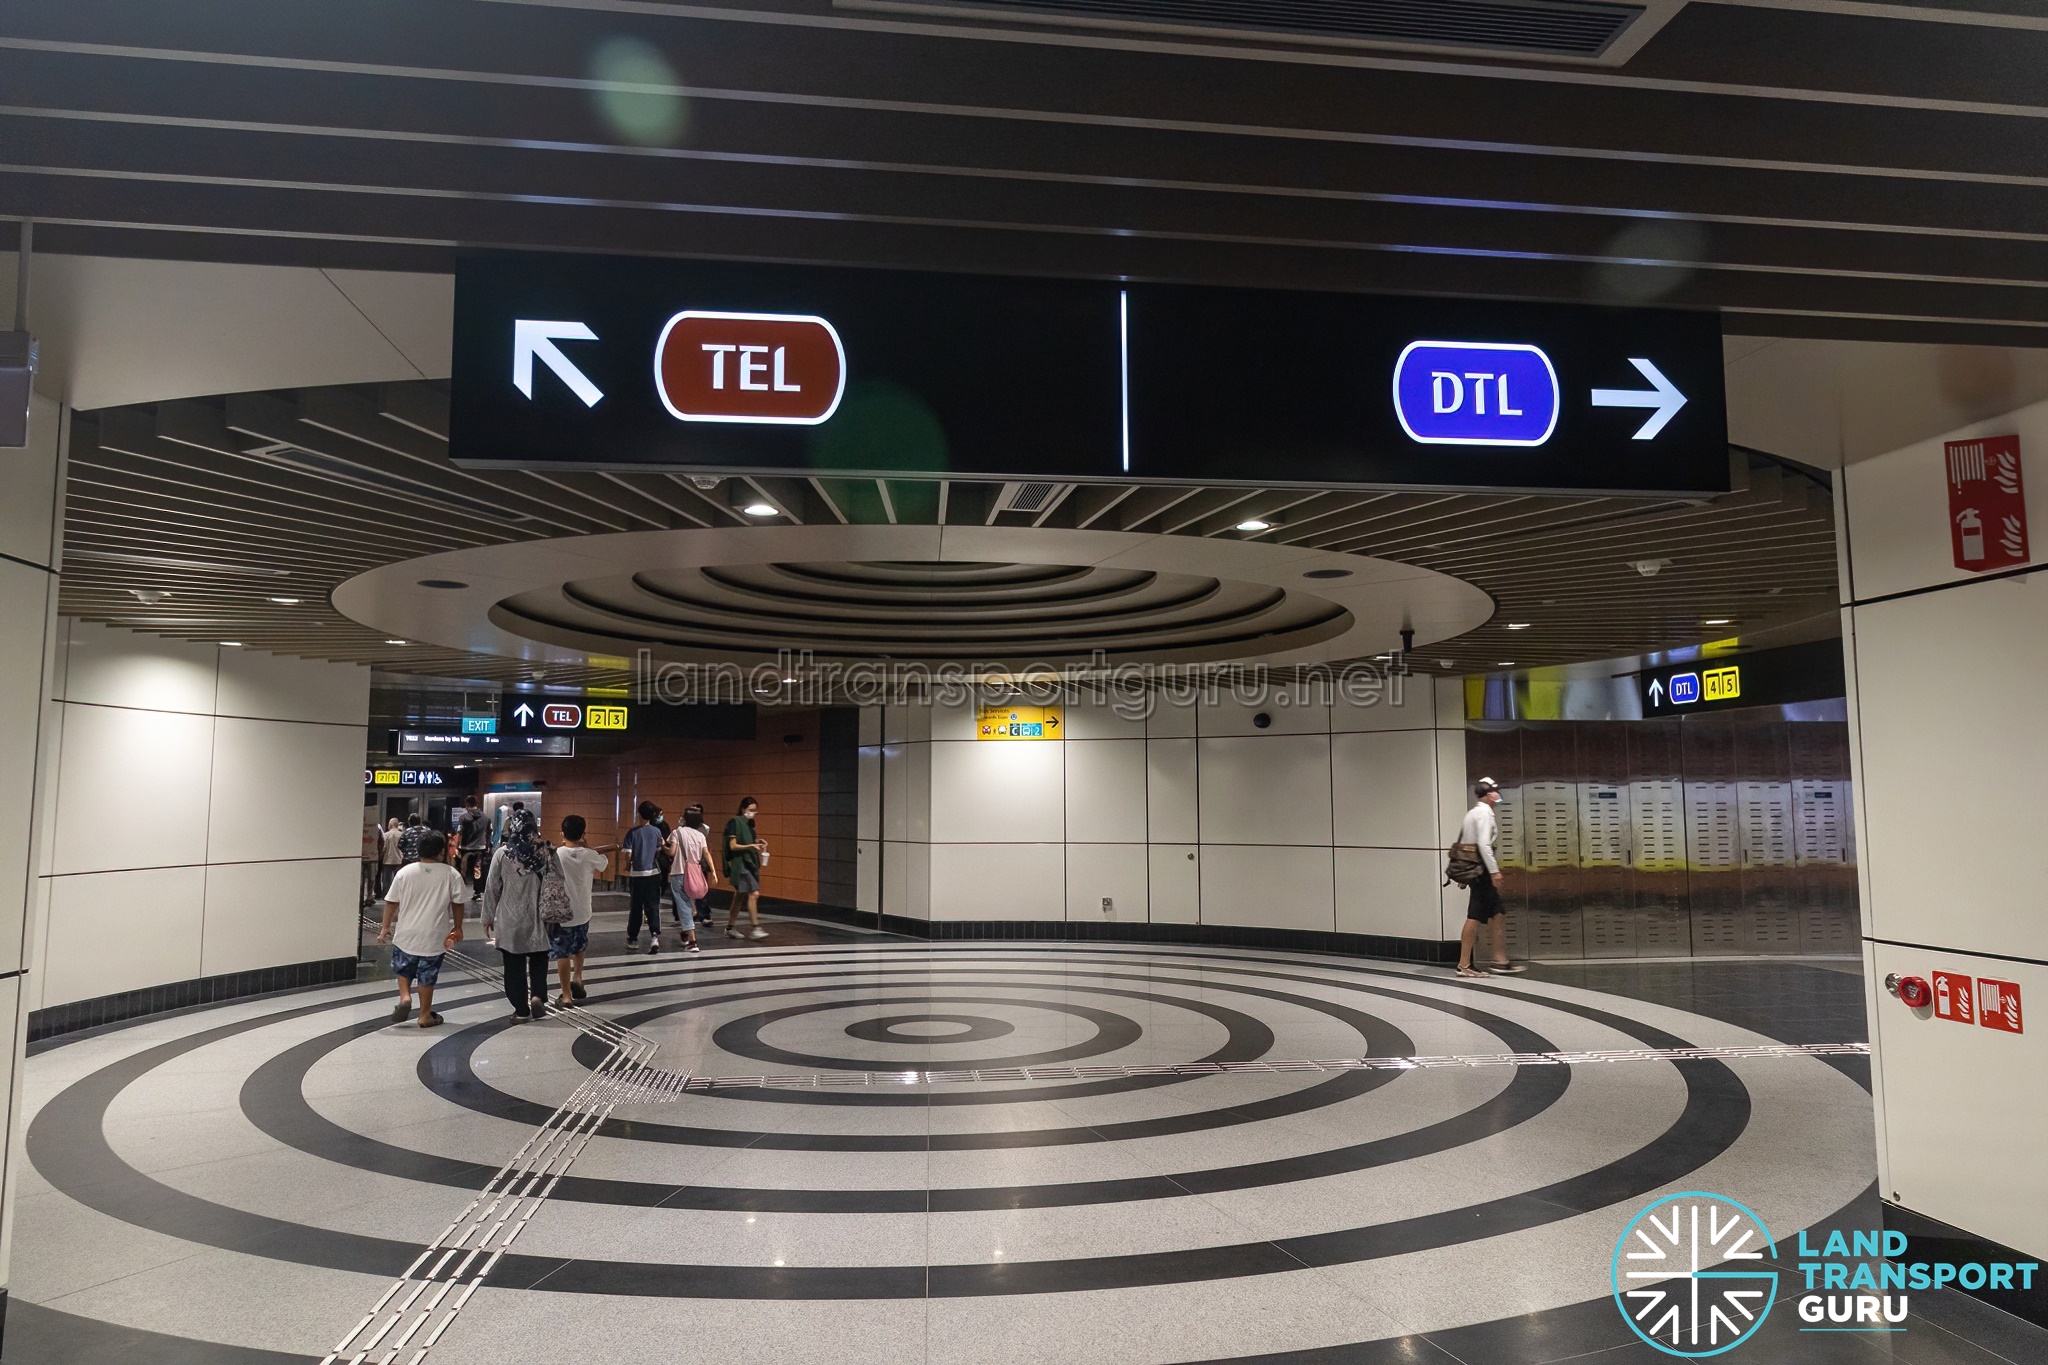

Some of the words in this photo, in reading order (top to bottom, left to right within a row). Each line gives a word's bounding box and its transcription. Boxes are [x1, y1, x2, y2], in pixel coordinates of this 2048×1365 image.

[702, 344, 801, 392] TEL
[1431, 371, 1523, 416] DTL
[1676, 682, 1693, 695] DTL
[1711, 681, 1716, 693] 4
[1727, 679, 1732, 692] 5
[552, 710, 573, 722] TEL
[595, 714, 602, 724] 2
[613, 714, 620, 725] 3
[468, 720, 490, 731] EXIT
[1034, 727, 1040, 736] 2
